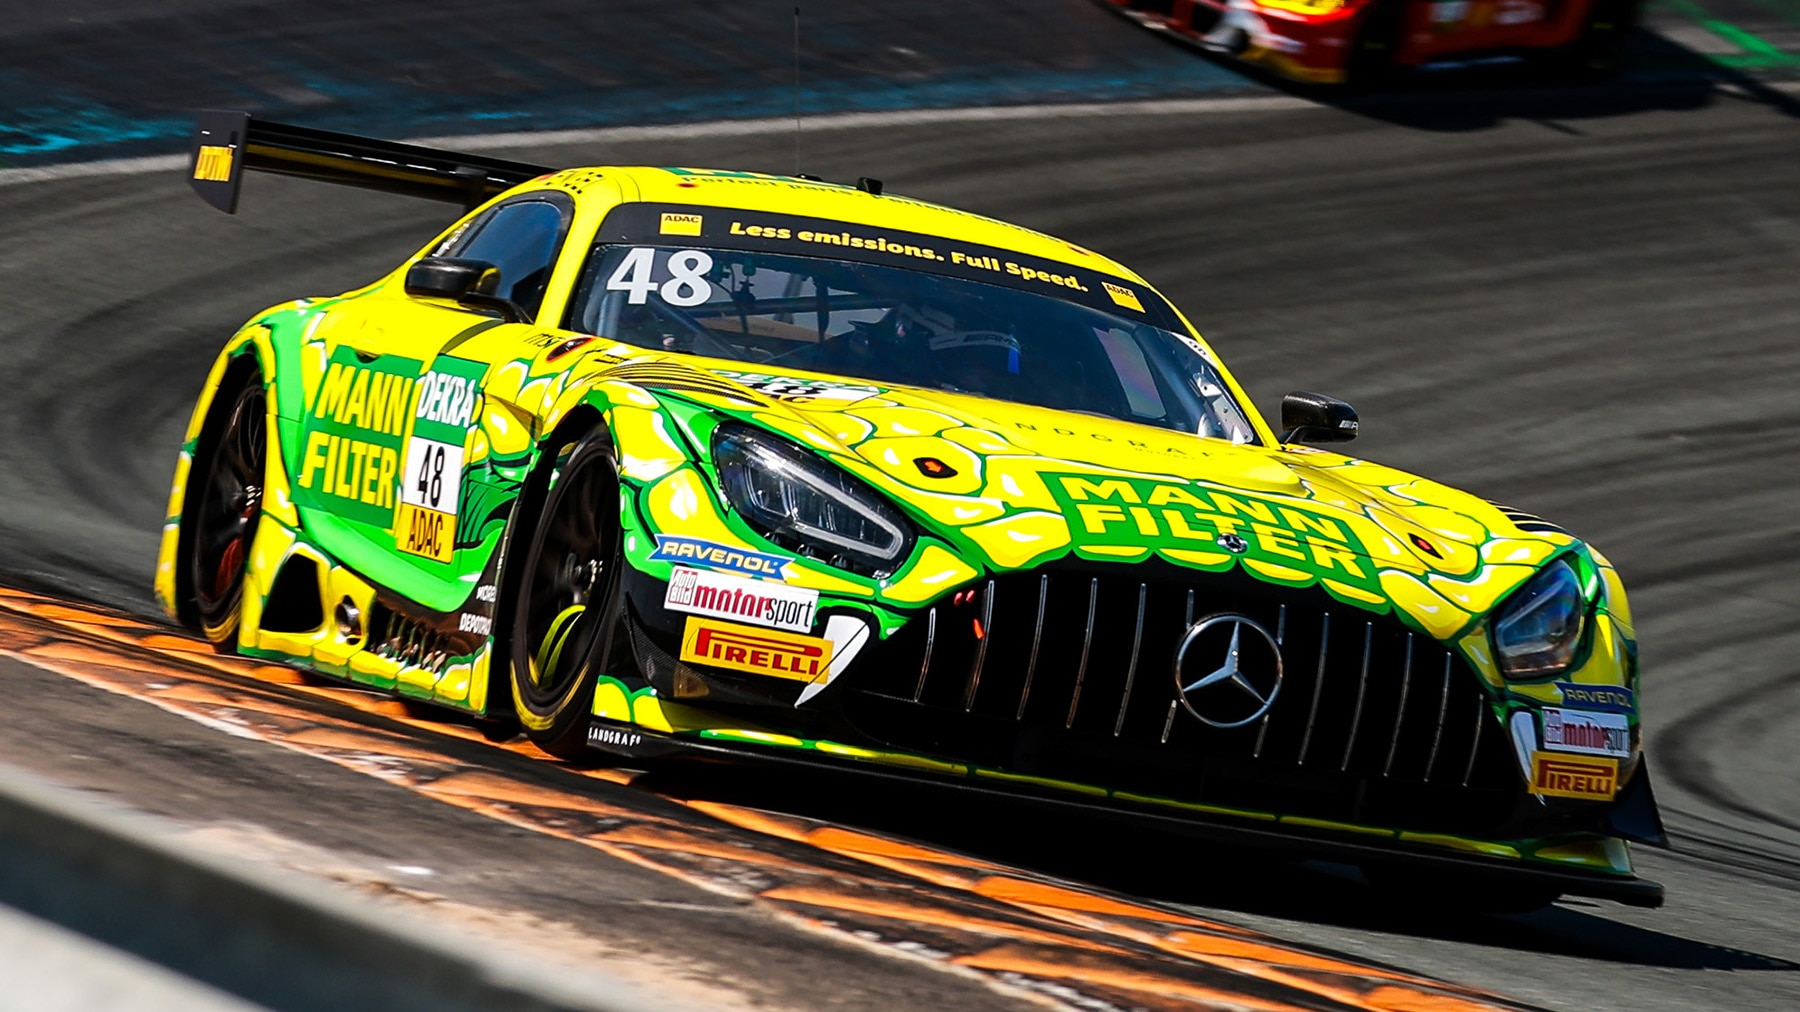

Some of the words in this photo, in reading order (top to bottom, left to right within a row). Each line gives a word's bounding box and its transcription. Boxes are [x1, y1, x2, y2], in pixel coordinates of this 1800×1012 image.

[664, 214, 700, 224] ADAC
[606, 247, 714, 307] 48
[729, 221, 792, 240] Less
[797, 230, 945, 261] emissions.
[951, 251, 1001, 272] Full
[1004, 261, 1089, 293] Speed.
[314, 362, 414, 437] MANN
[415, 370, 477, 428] DEKRA
[298, 430, 399, 510] FILTER
[417, 444, 446, 508] 48
[405, 509, 444, 558] ADAC
[1058, 476, 1348, 544] MANN
[661, 541, 777, 575] RAVENOL
[1075, 502, 1367, 580] FILTER
[694, 627, 823, 676] PIRELLI
[1538, 759, 1615, 795] PIRELLI
